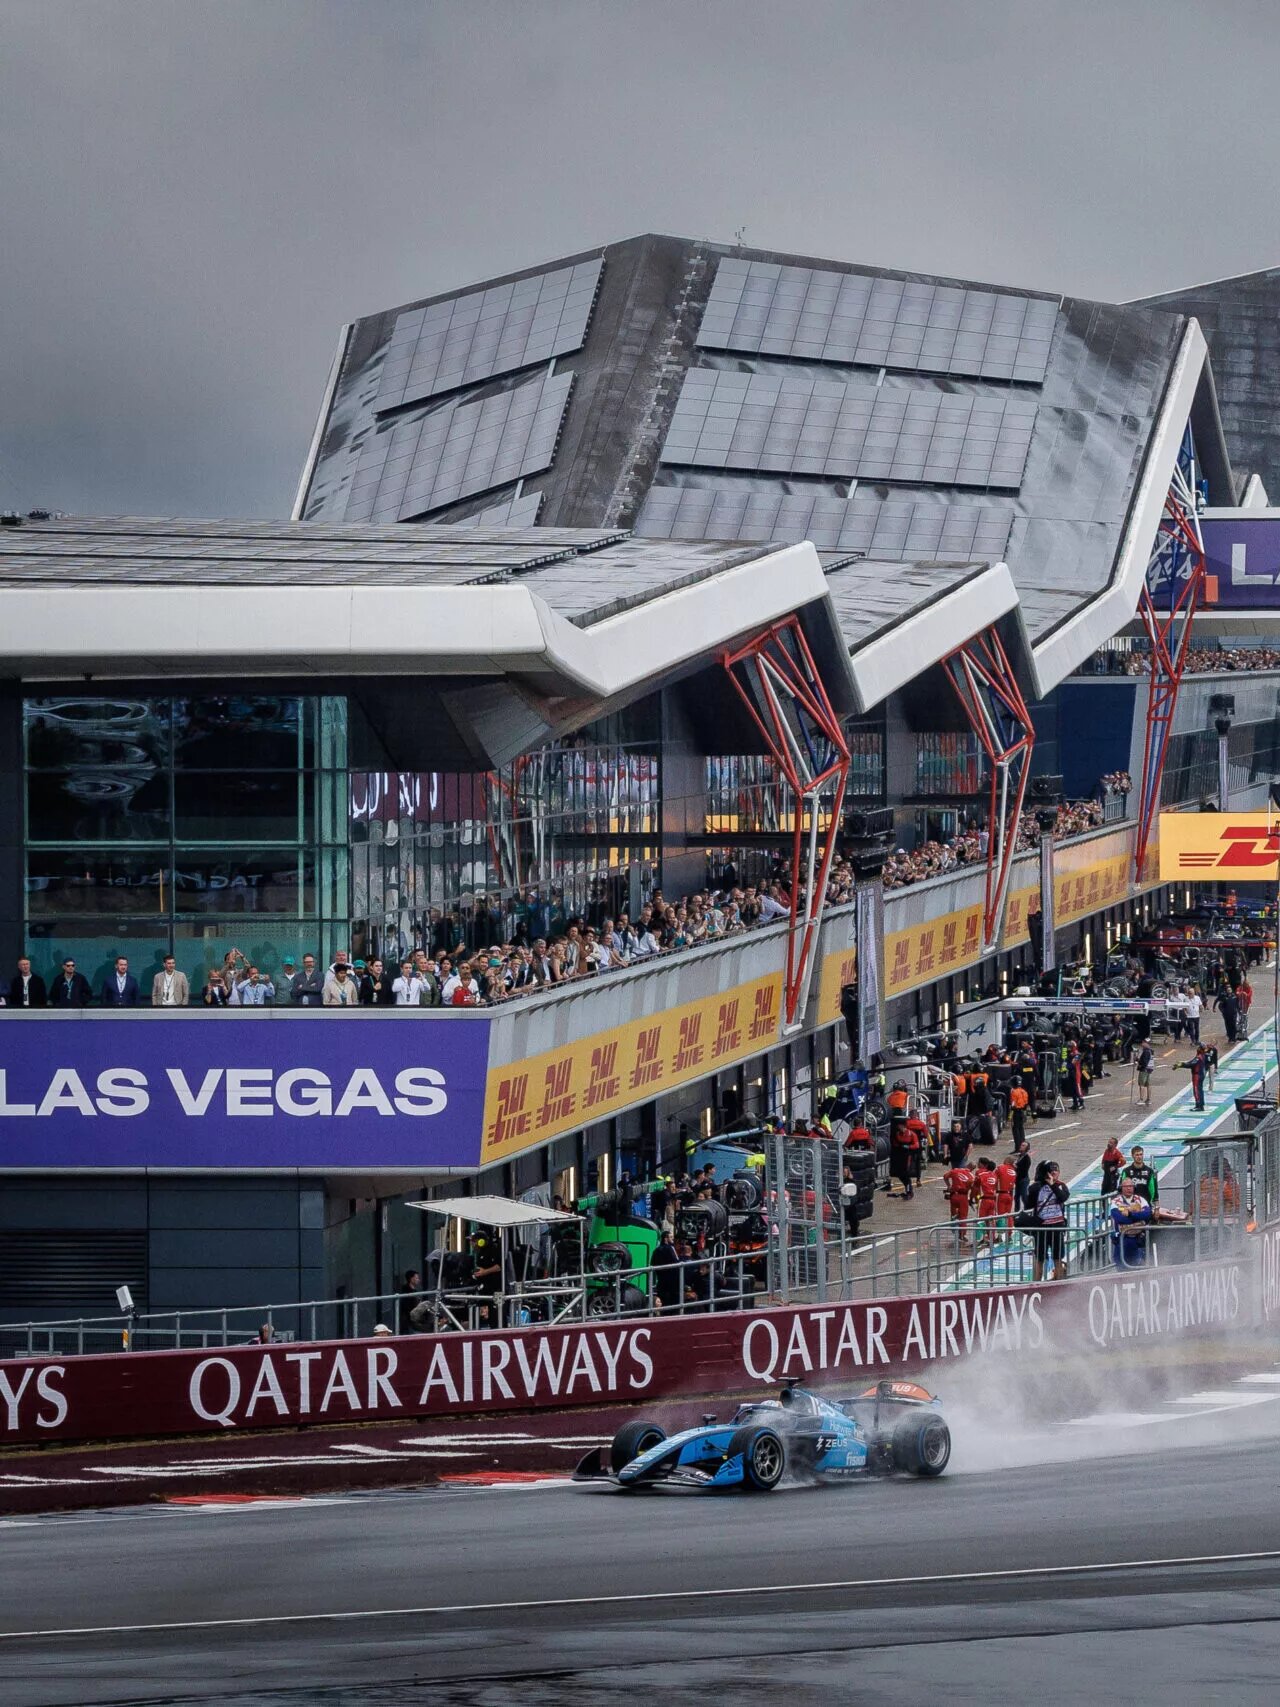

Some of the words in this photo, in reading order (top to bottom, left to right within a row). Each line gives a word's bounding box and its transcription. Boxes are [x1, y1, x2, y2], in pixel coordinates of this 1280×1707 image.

[0, 1068, 149, 1117] LAS
[166, 1068, 448, 1117] VEGAS
[743, 1306, 891, 1383] QATAR
[902, 1292, 1043, 1361] AIRWAYS
[1088, 1280, 1162, 1347] QATAR
[1166, 1266, 1239, 1331] AIRWAYS
[189, 1347, 403, 1427] QATAR
[418, 1328, 654, 1406] AIRWAYS
[825, 1439, 848, 1448] ZEUS
